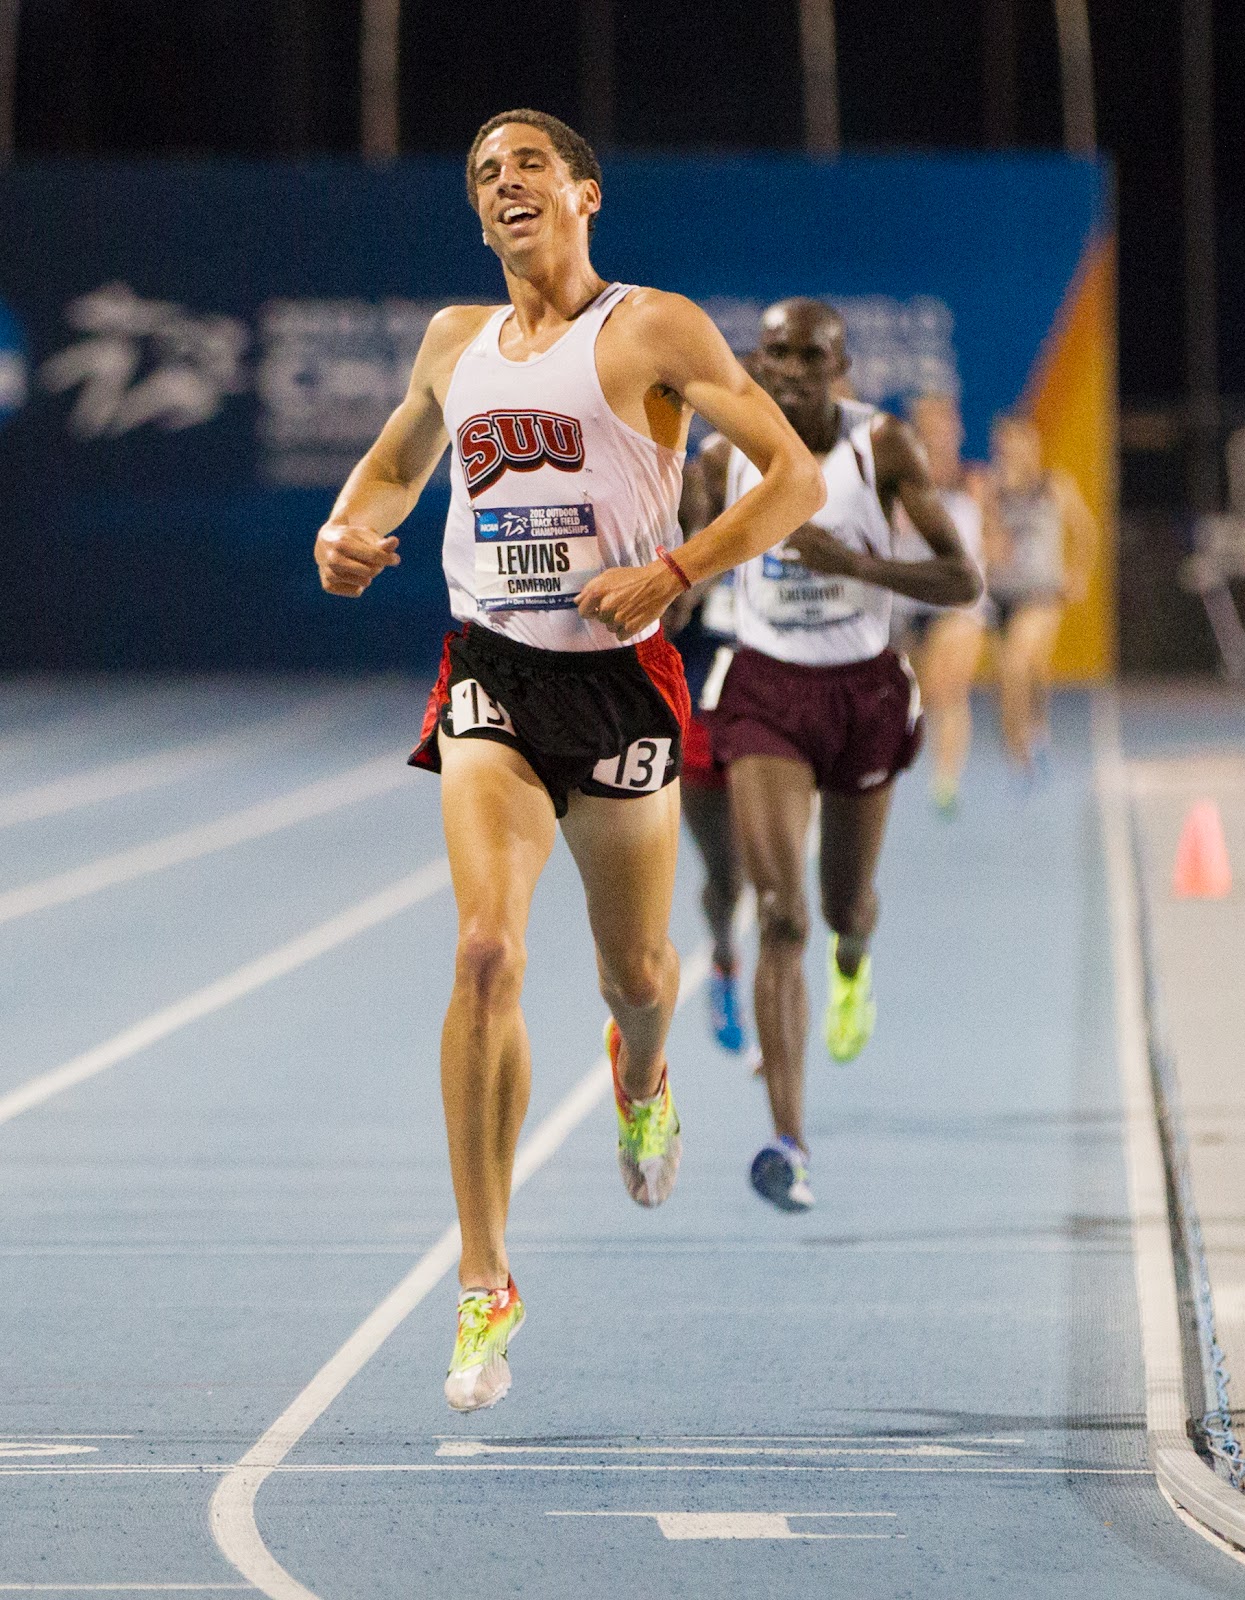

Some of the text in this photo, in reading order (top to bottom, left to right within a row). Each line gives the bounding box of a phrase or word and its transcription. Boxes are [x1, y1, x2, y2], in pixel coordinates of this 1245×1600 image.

[457, 409, 585, 500] SUU
[530, 507, 579, 518] 2012 OUTDOOR
[480, 523, 499, 532] NCAA
[530, 517, 552, 527] TRACK
[560, 516, 580, 526] FIELD
[531, 524, 589, 537] CHAMPIONSHIPS
[496, 542, 570, 576] LEVINS
[507, 577, 561, 594] CAMERON
[614, 740, 658, 788] 13
